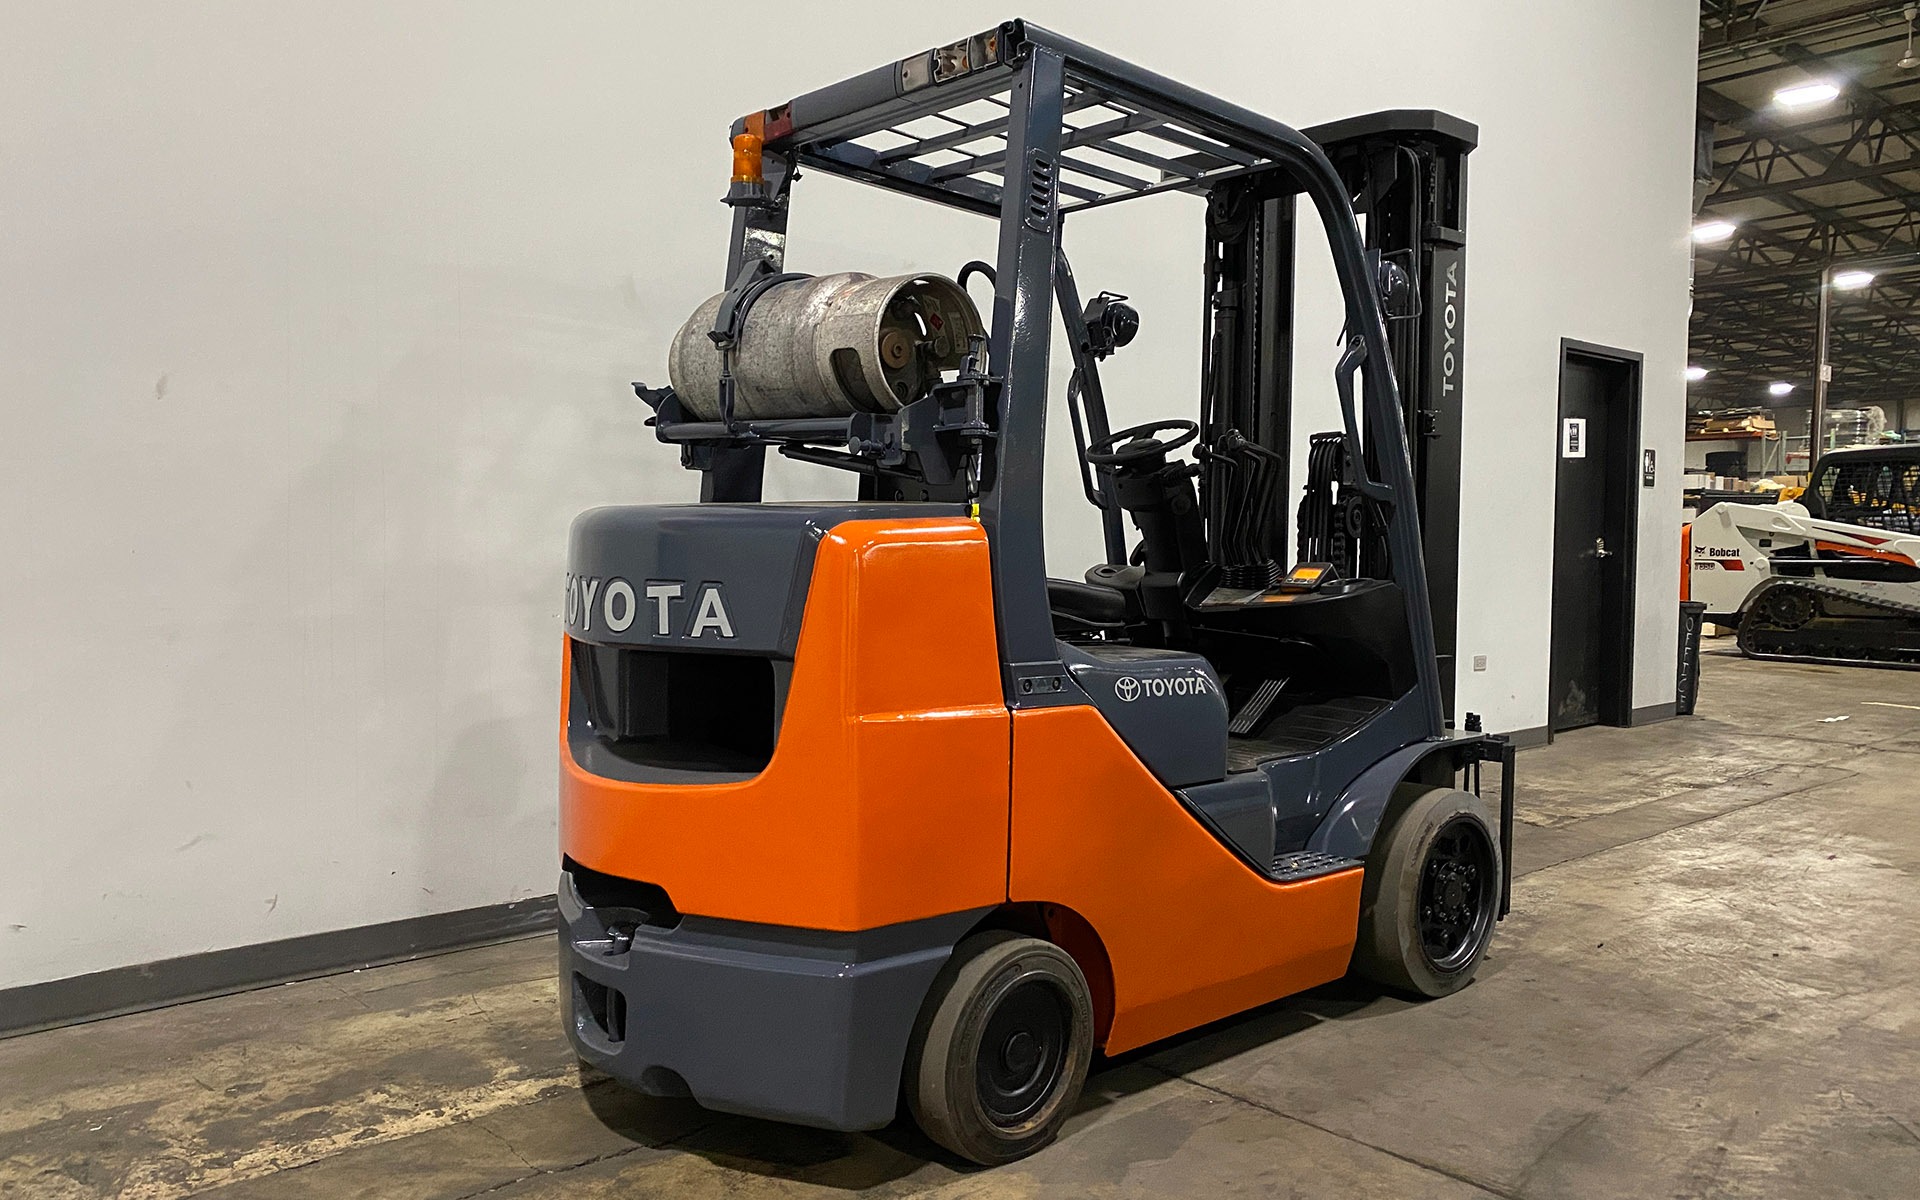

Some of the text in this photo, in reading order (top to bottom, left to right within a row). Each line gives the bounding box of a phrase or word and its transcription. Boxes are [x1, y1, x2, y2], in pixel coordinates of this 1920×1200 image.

[1442, 261, 1458, 397] TOYOTA
[1709, 548, 1740, 557] Bobcat
[1142, 677, 1208, 697] TOYOTA
